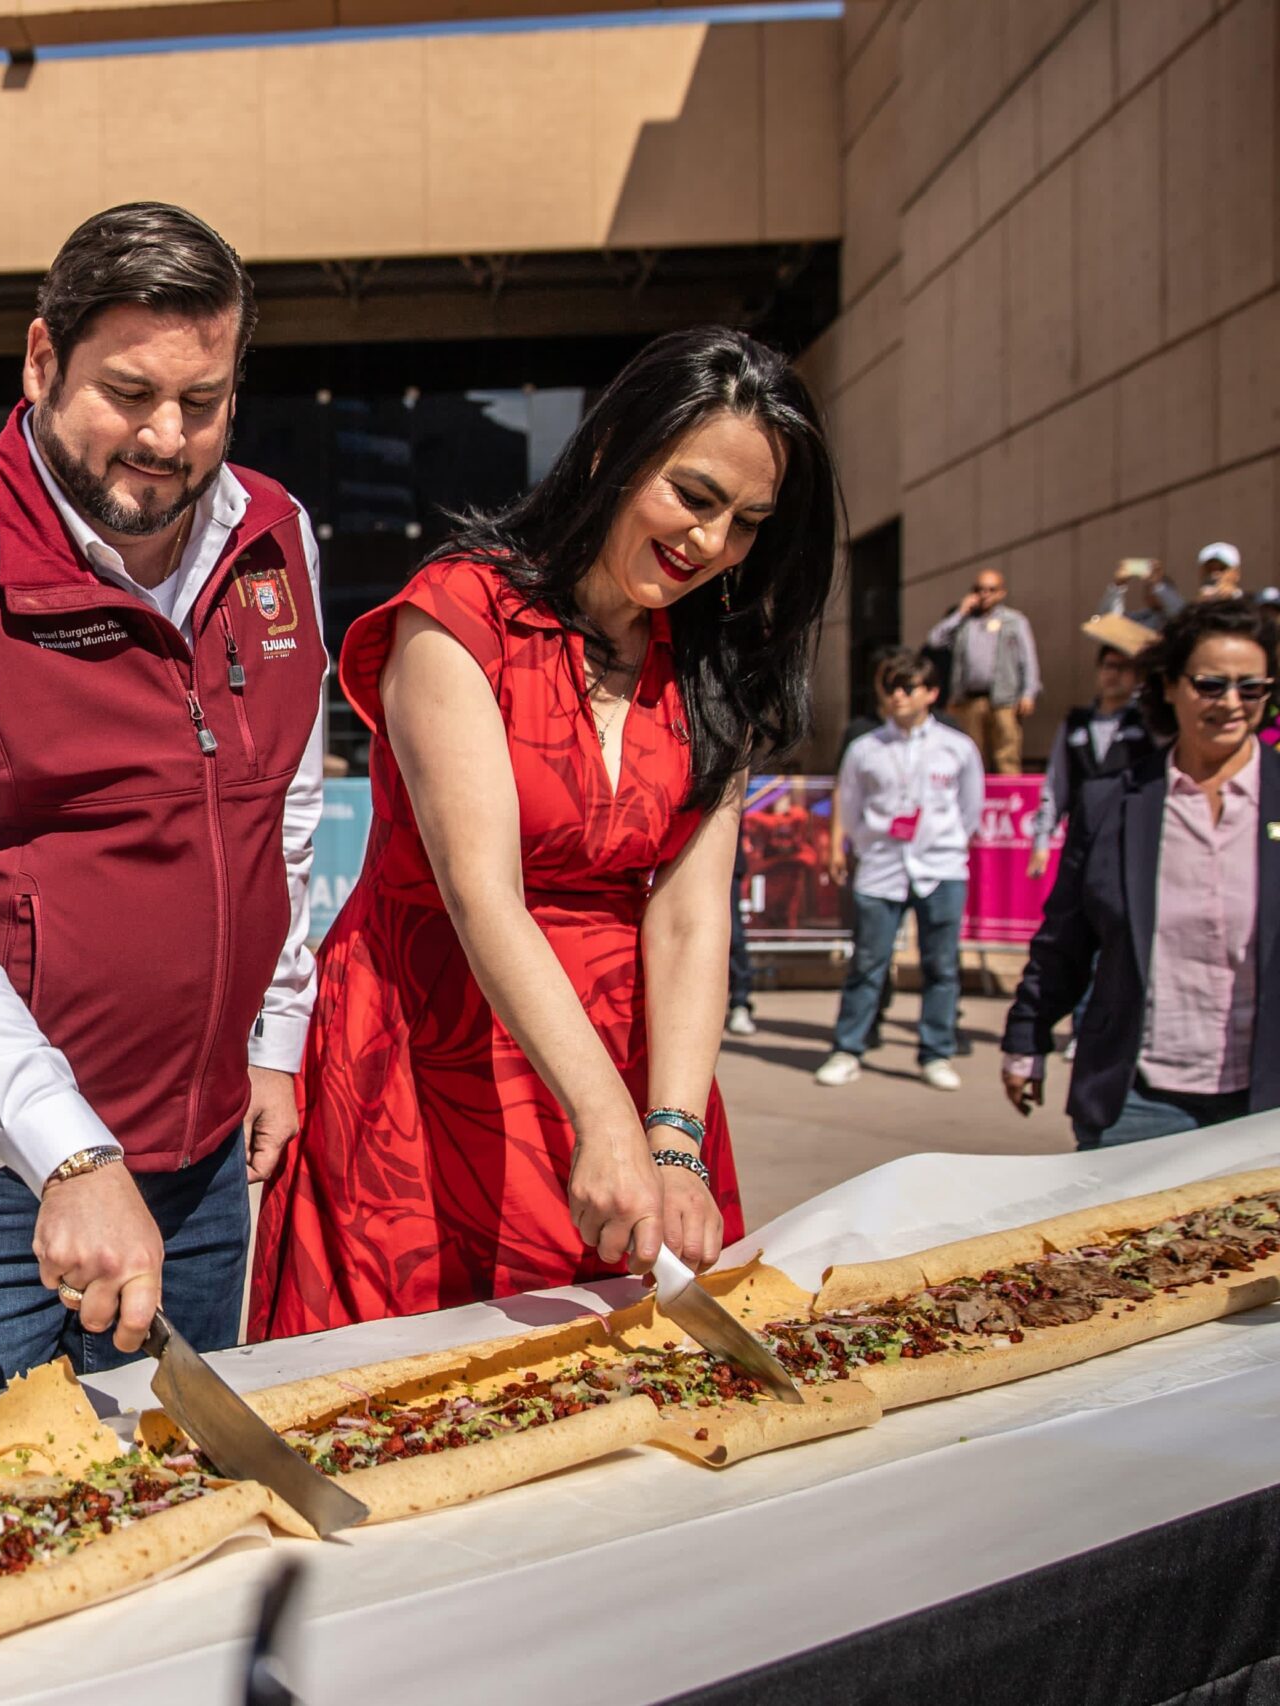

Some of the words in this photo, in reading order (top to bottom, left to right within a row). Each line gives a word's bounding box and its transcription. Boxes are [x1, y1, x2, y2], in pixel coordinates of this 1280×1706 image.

[32, 630, 58, 639] Ismael
[59, 623, 106, 639] Burgueño
[39, 640, 81, 649] Presidente
[82, 631, 129, 646] Municipal
[261, 637, 297, 652] TIJUANA
